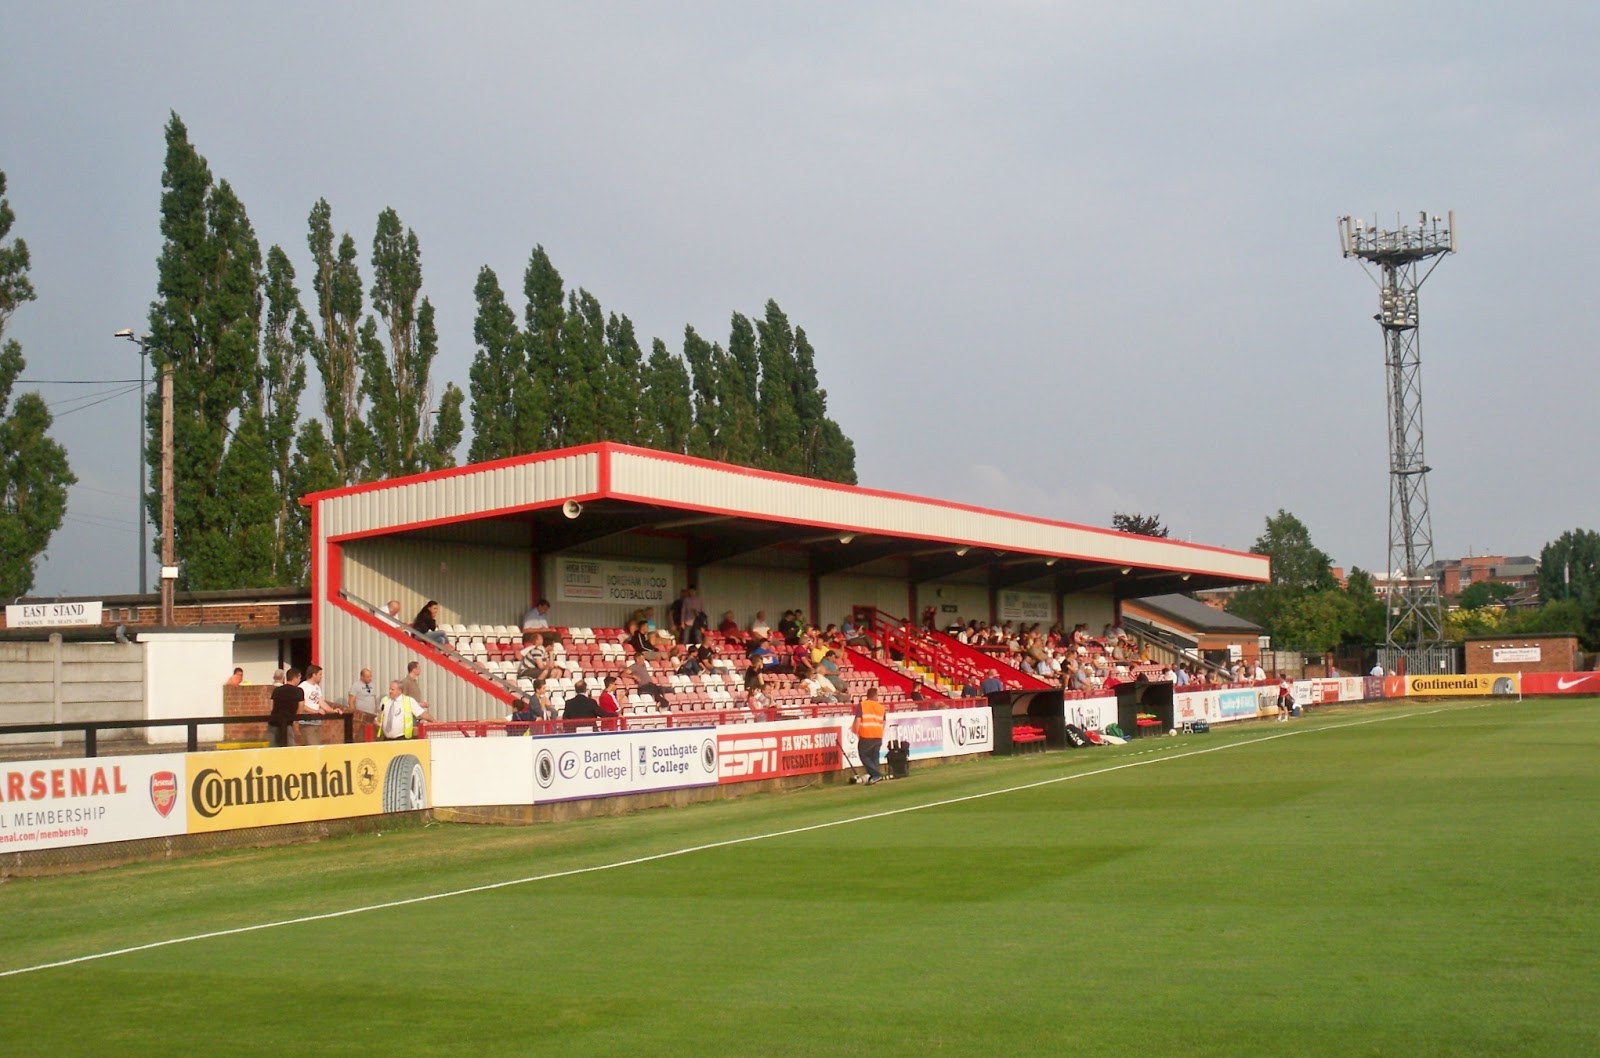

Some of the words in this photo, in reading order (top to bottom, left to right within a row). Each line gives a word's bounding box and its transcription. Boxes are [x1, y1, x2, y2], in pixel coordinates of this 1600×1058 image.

[607, 575, 641, 587] BOREHAM
[642, 577, 667, 588] WOOD
[610, 588, 644, 600] FOOTBALL
[645, 590, 663, 600] CLUB
[23, 606, 47, 617] EAST
[53, 604, 84, 616] STAND
[1412, 678, 1478, 692] Continental
[968, 725, 985, 739] WSL
[782, 735, 792, 751] FA
[793, 734, 813, 750] WSL
[814, 732, 837, 749] SHOW
[584, 749, 621, 763] Barnet
[652, 743, 698, 759] Southgate
[719, 737, 778, 777] ESPN
[652, 760, 689, 774] College
[782, 754, 813, 770] TUESDAY
[584, 765, 627, 780] College
[0, 766, 127, 803] RSENAL
[153, 778, 175, 787] Arsenal
[191, 760, 354, 818] Continental
[14, 806, 106, 827] MEMBERSHIP
